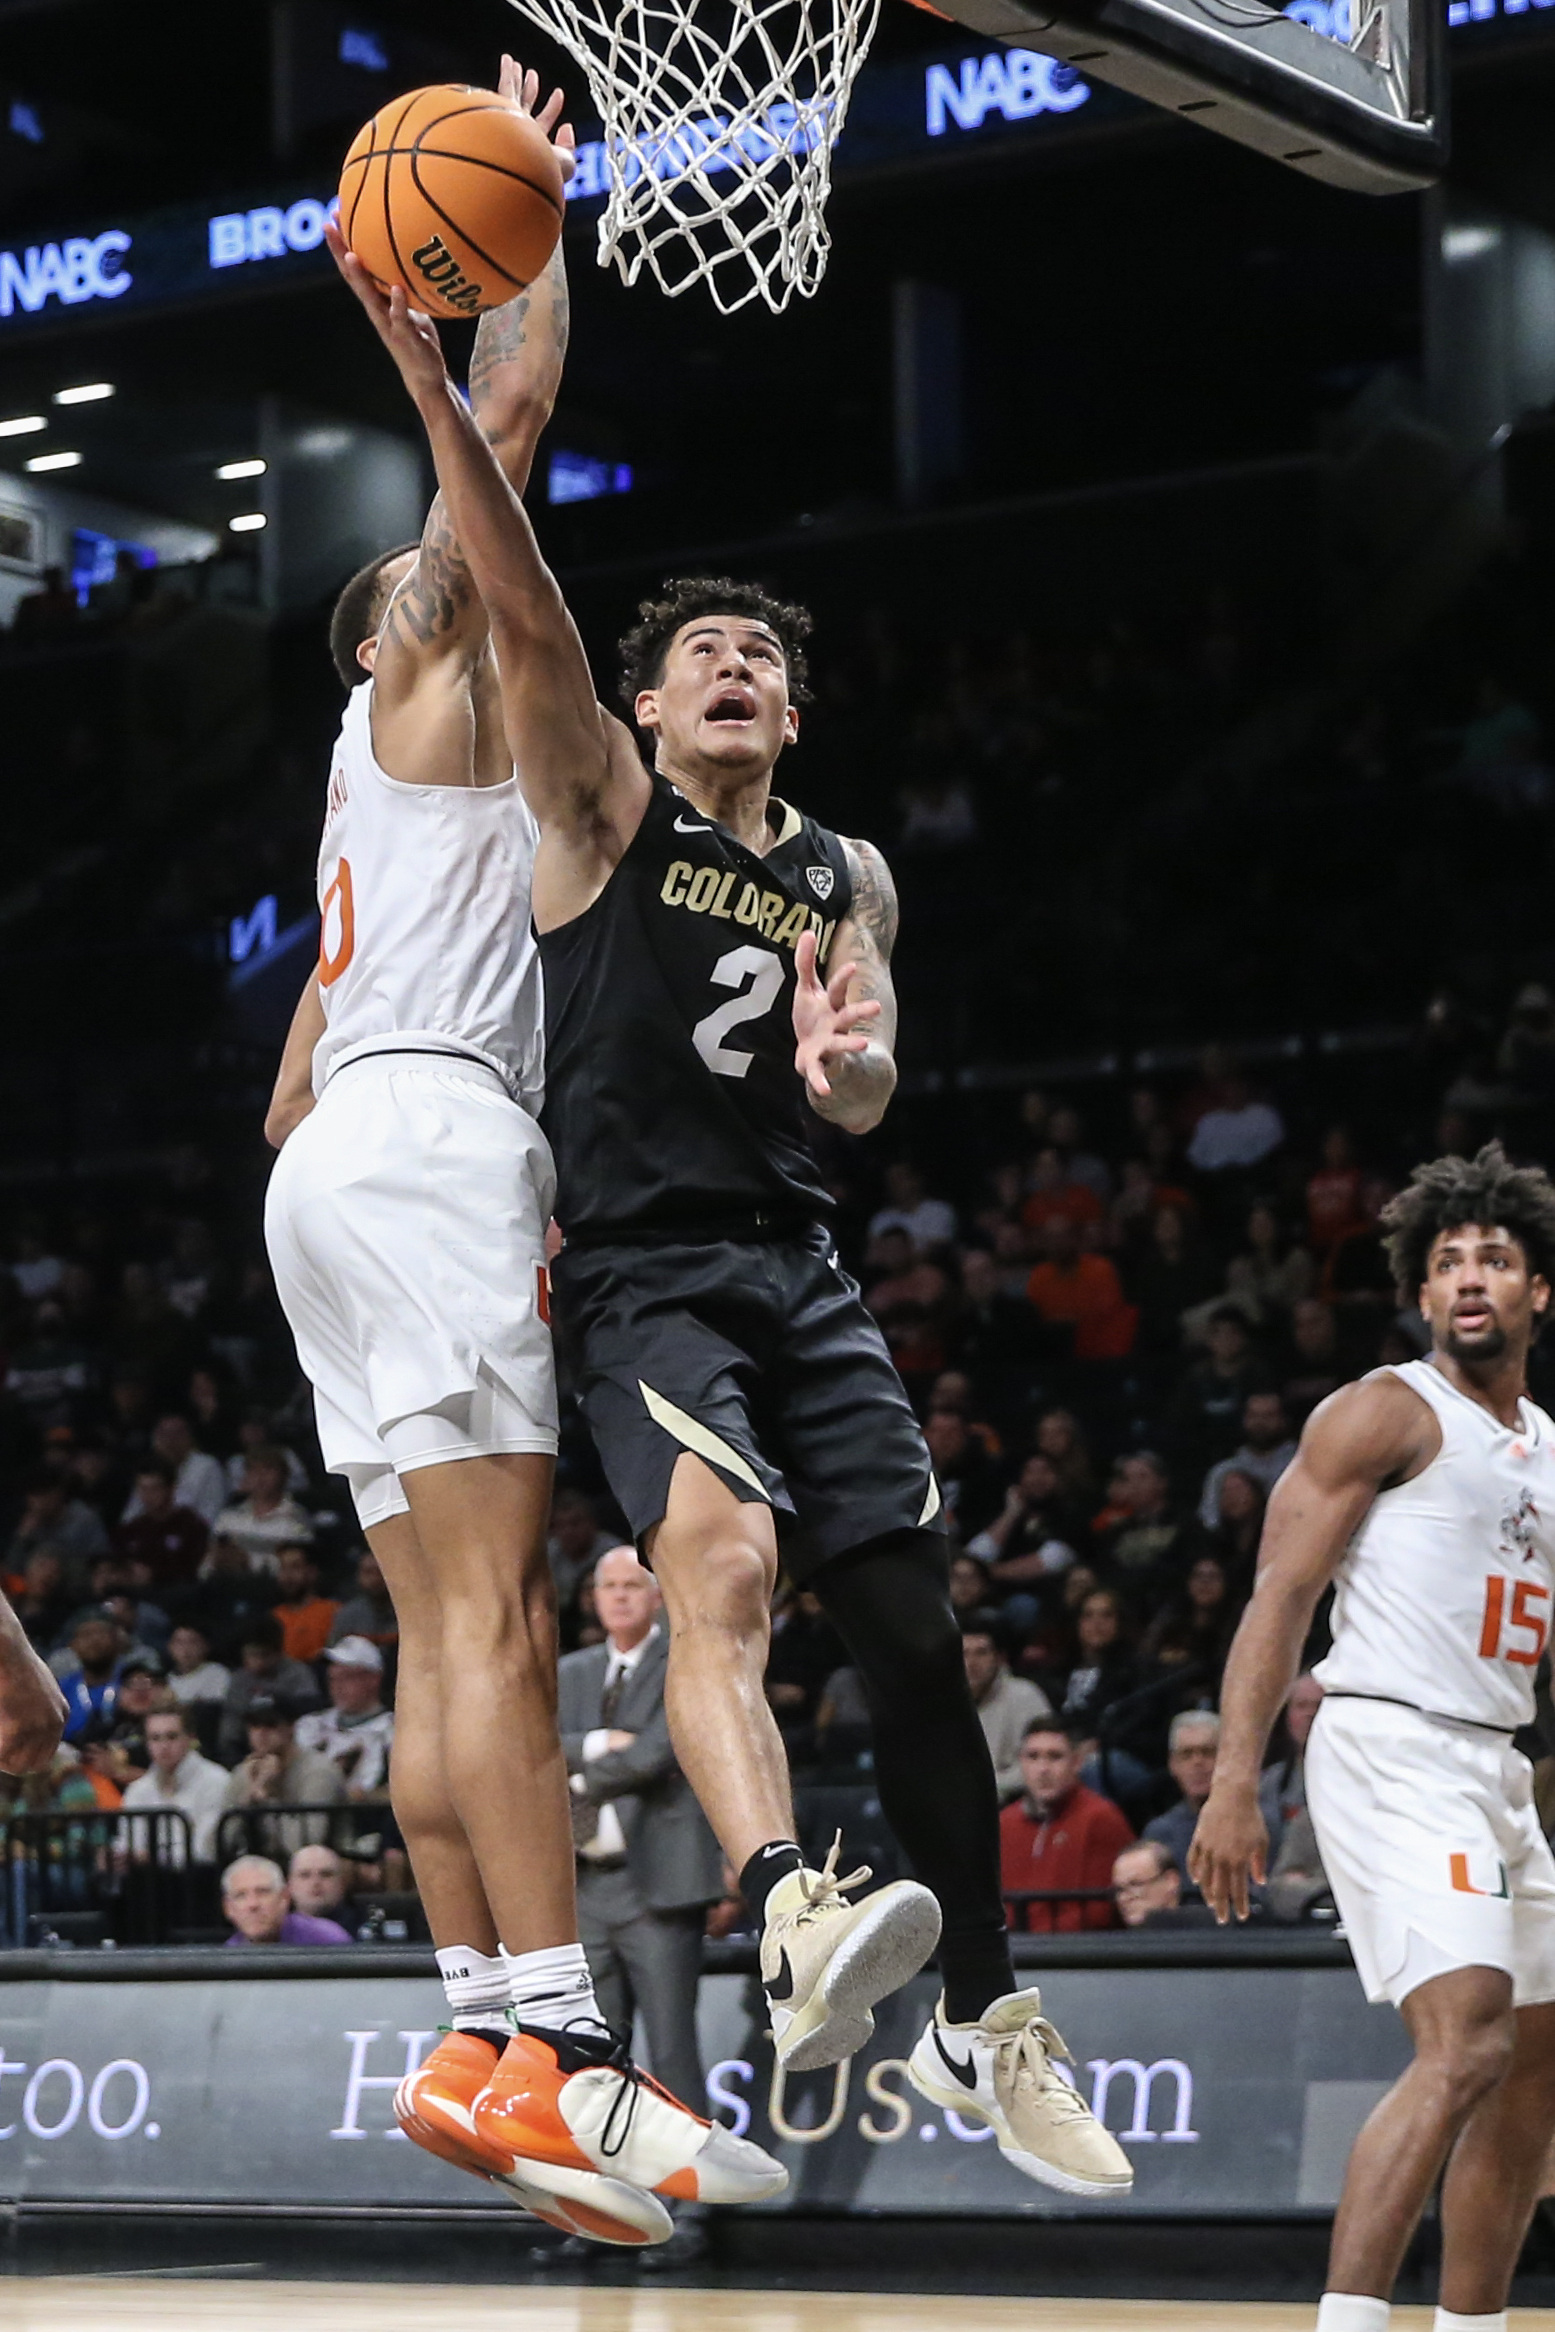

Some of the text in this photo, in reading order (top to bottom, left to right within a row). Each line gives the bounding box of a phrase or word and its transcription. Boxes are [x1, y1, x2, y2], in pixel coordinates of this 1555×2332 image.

[926, 48, 1091, 136] NABC
[0, 229, 132, 317] NABC
[691, 944, 786, 1078] 2
[1478, 1574, 1549, 1666] 15
